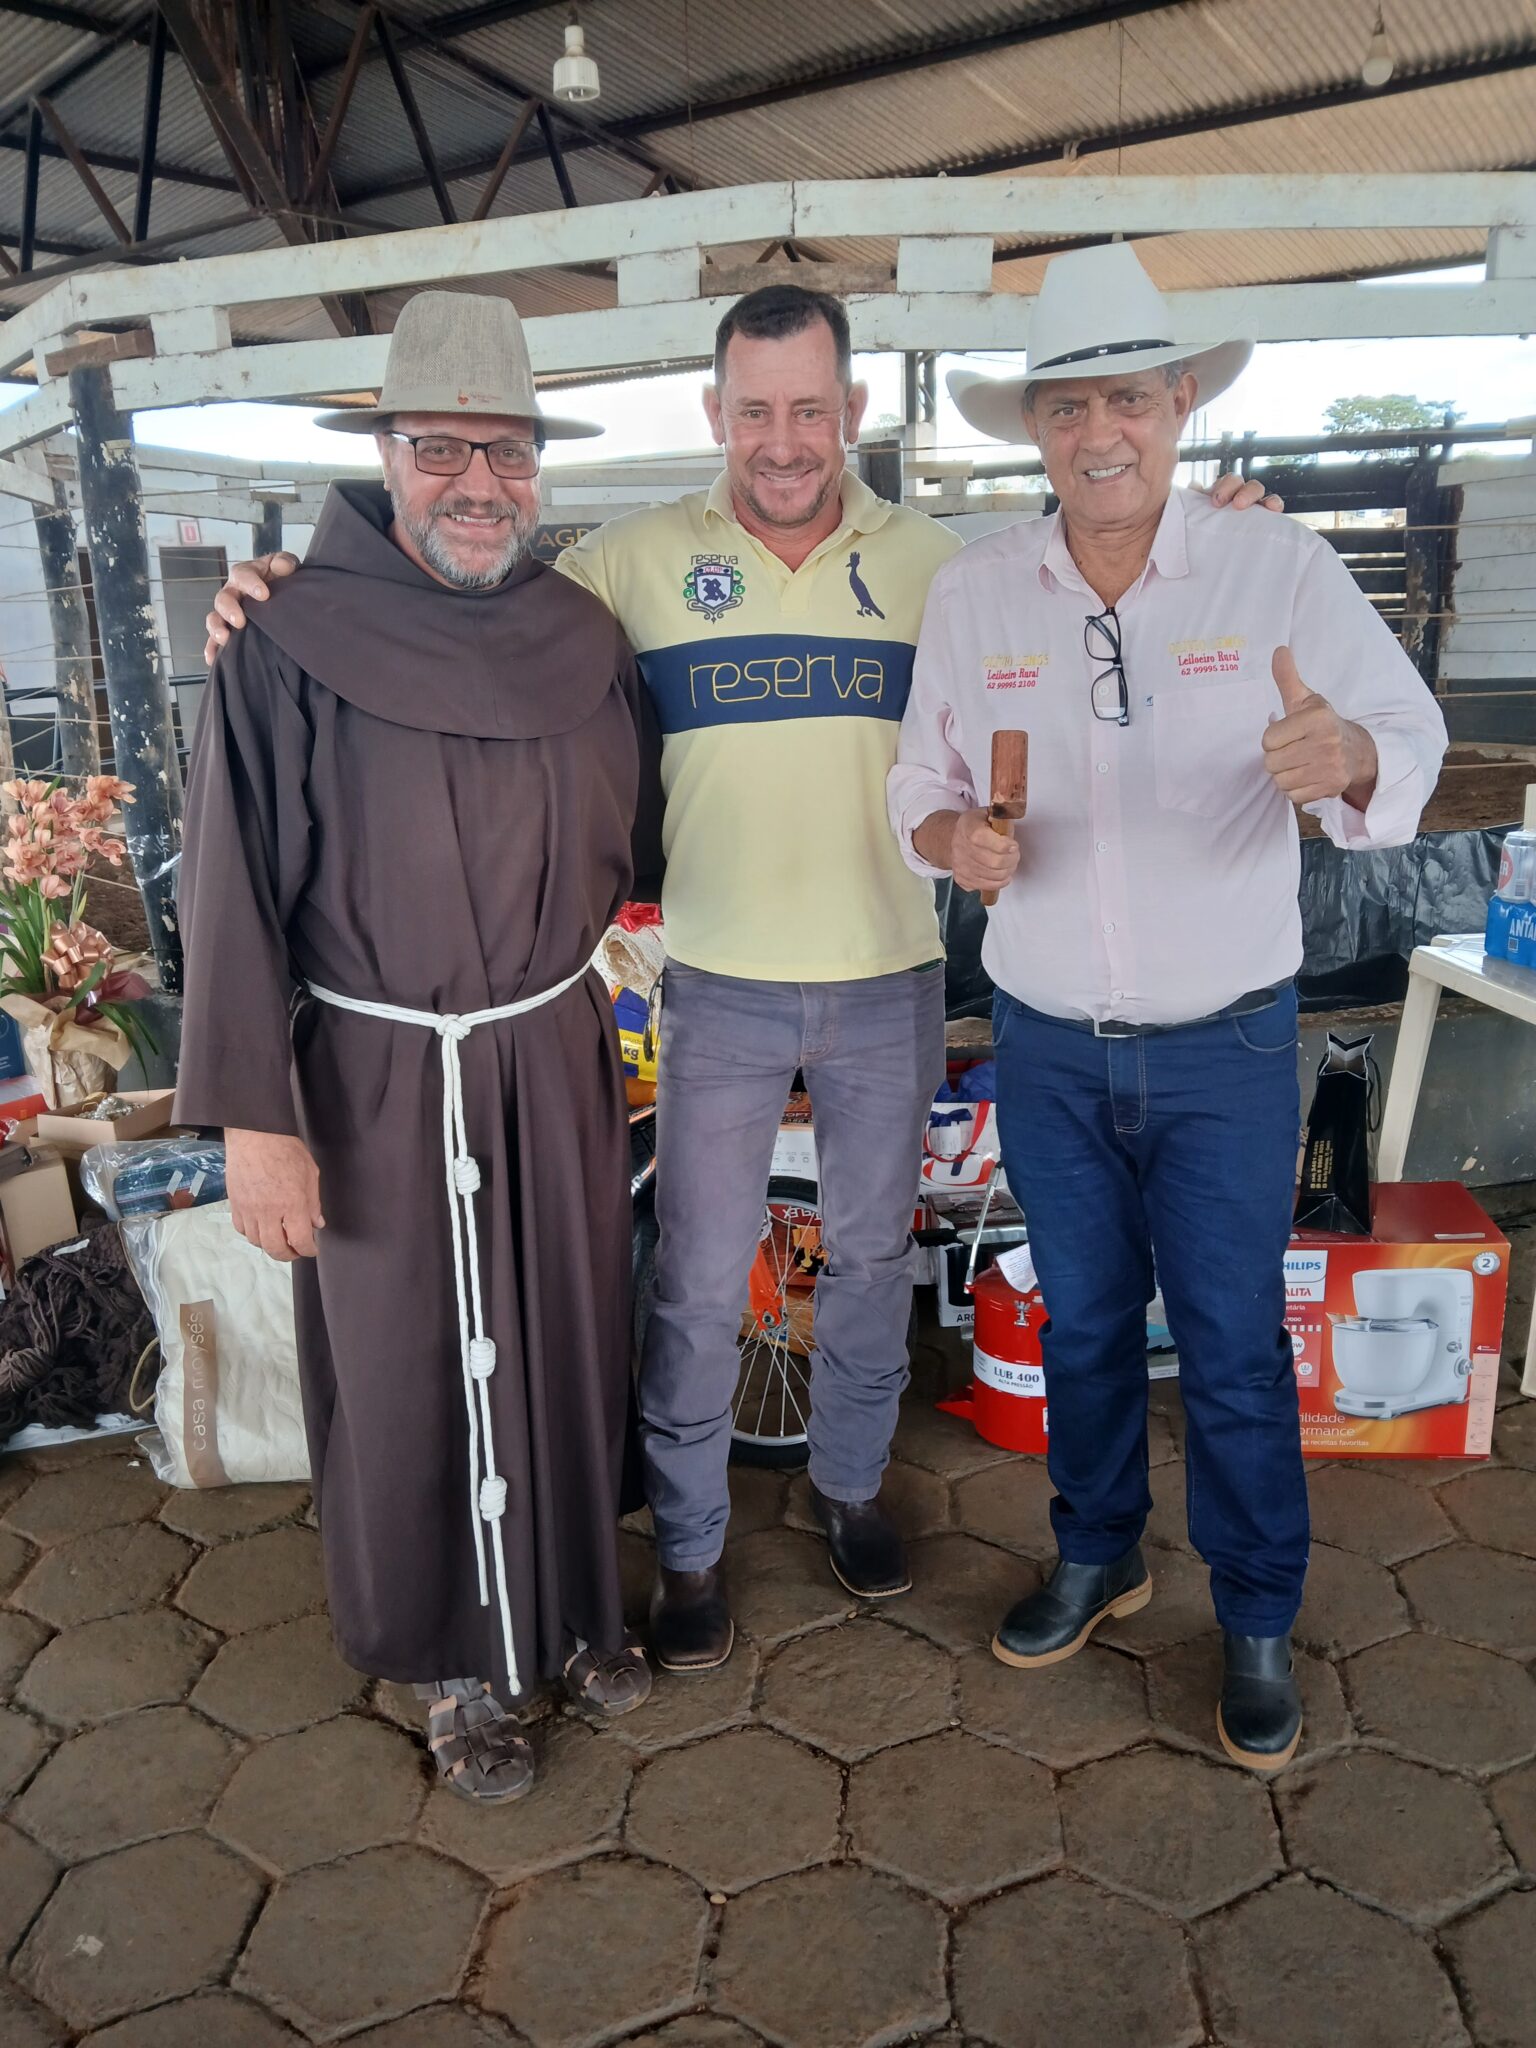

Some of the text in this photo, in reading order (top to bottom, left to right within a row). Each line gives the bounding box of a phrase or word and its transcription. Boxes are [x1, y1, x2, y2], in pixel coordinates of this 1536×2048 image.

[691, 554, 738, 565] reserva
[1178, 650, 1239, 666] Leiloeiro Rural
[1019, 667, 1039, 677] Rural
[1181, 668, 1191, 676] 62
[1193, 665, 1217, 673] 99995
[689, 654, 884, 708] reserva
[997, 681, 1016, 689] 99995
[1018, 680, 1036, 688] 2100
[1509, 918, 1536, 942] ANTA
[623, 1046, 639, 1061] kg
[1482, 1258, 1491, 1268] 2
[994, 1366, 1040, 1383] LUB 400
[193, 1398, 208, 1451] casa
